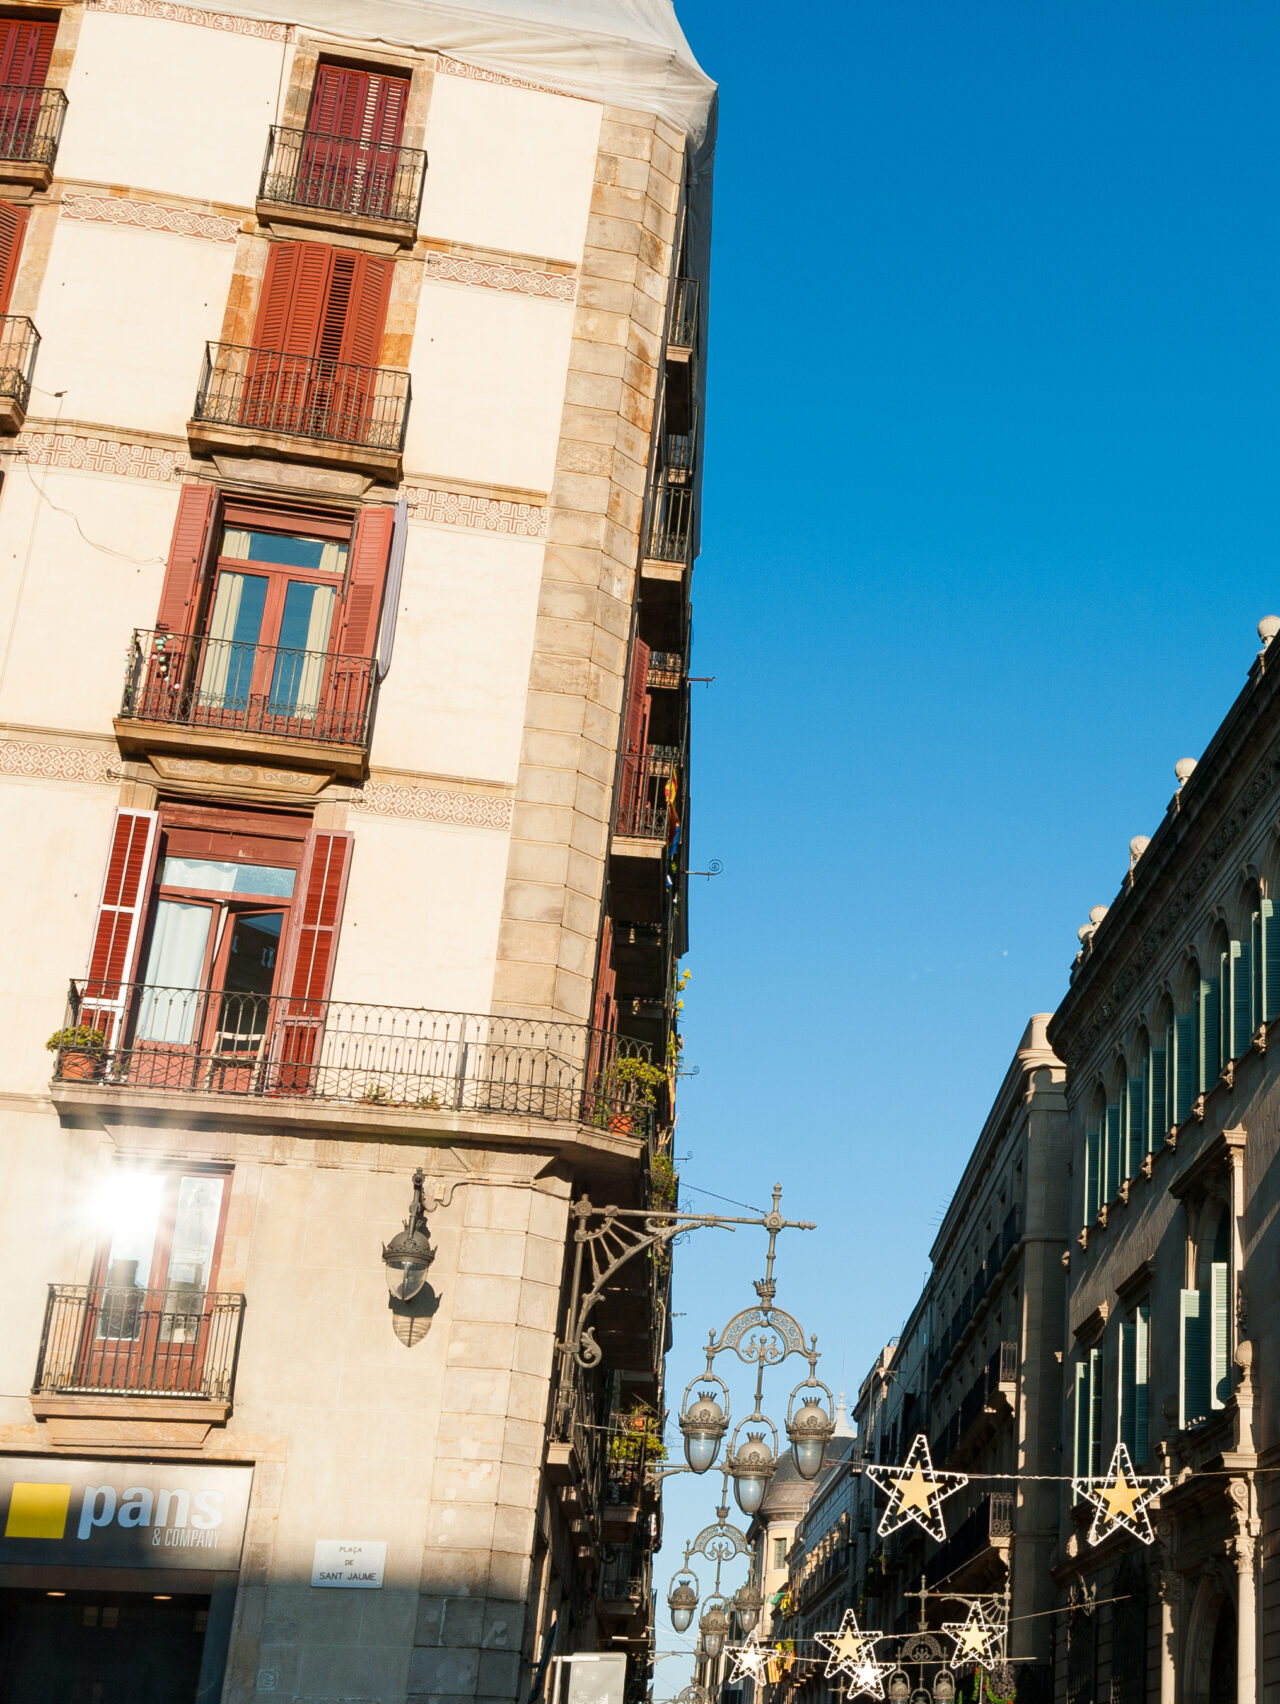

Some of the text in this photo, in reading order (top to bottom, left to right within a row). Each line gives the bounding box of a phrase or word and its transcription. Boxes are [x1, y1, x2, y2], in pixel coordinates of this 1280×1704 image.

[76, 1485, 223, 1540] pans
[152, 1527, 222, 1548] & COMPANY
[339, 1546, 363, 1554] PLAÇA
[319, 1571, 376, 1581] SANT JAUME
